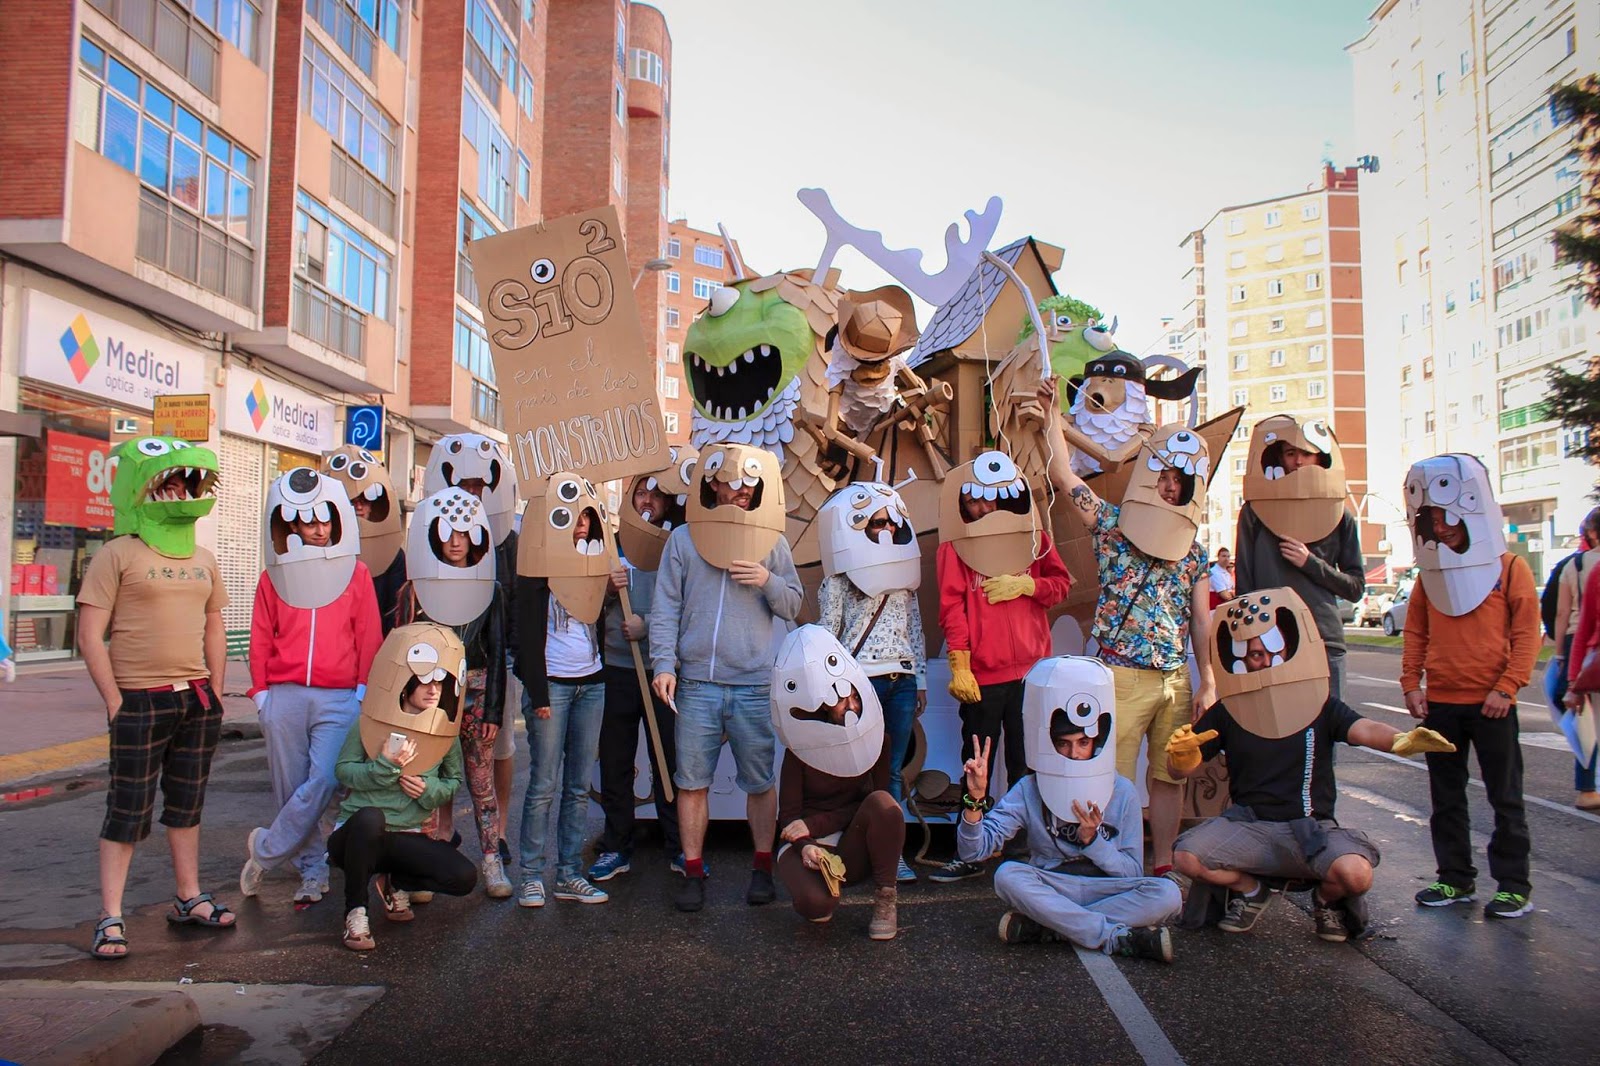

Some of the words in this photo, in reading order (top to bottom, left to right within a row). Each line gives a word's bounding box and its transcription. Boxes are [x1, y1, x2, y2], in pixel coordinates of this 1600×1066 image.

[106, 337, 179, 389] Medical
[514, 366, 552, 385] en
[569, 337, 600, 371] el
[567, 379, 592, 399] de
[603, 368, 638, 392] los
[156, 409, 170, 418] CAJA
[273, 395, 318, 432] Medical
[515, 398, 660, 480] MONSTRUOS
[95, 496, 113, 507] MILE
